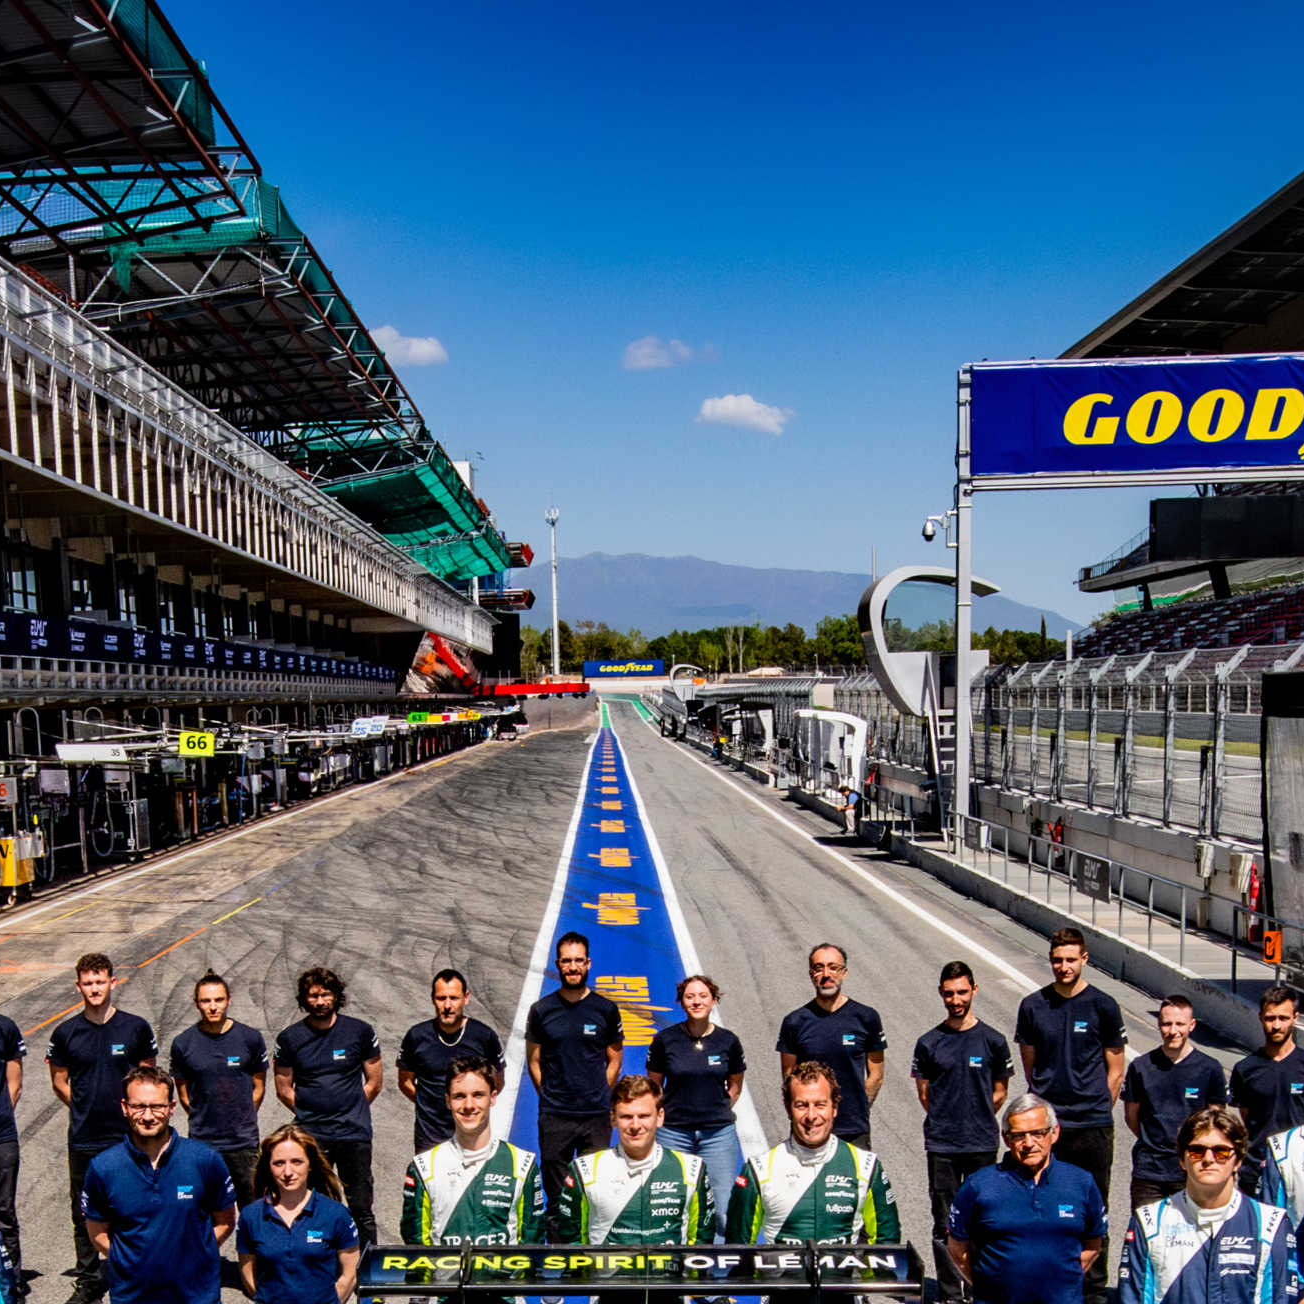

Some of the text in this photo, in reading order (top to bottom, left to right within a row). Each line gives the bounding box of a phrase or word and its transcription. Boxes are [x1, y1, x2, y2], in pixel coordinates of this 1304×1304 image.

[599, 663, 654, 674] GOODYEAR
[186, 735, 207, 751] 66
[651, 1206, 680, 1217] xmco
[383, 1256, 531, 1270] RACNG
[544, 1256, 673, 1270] SPIRIT
[683, 1255, 740, 1269] OF
